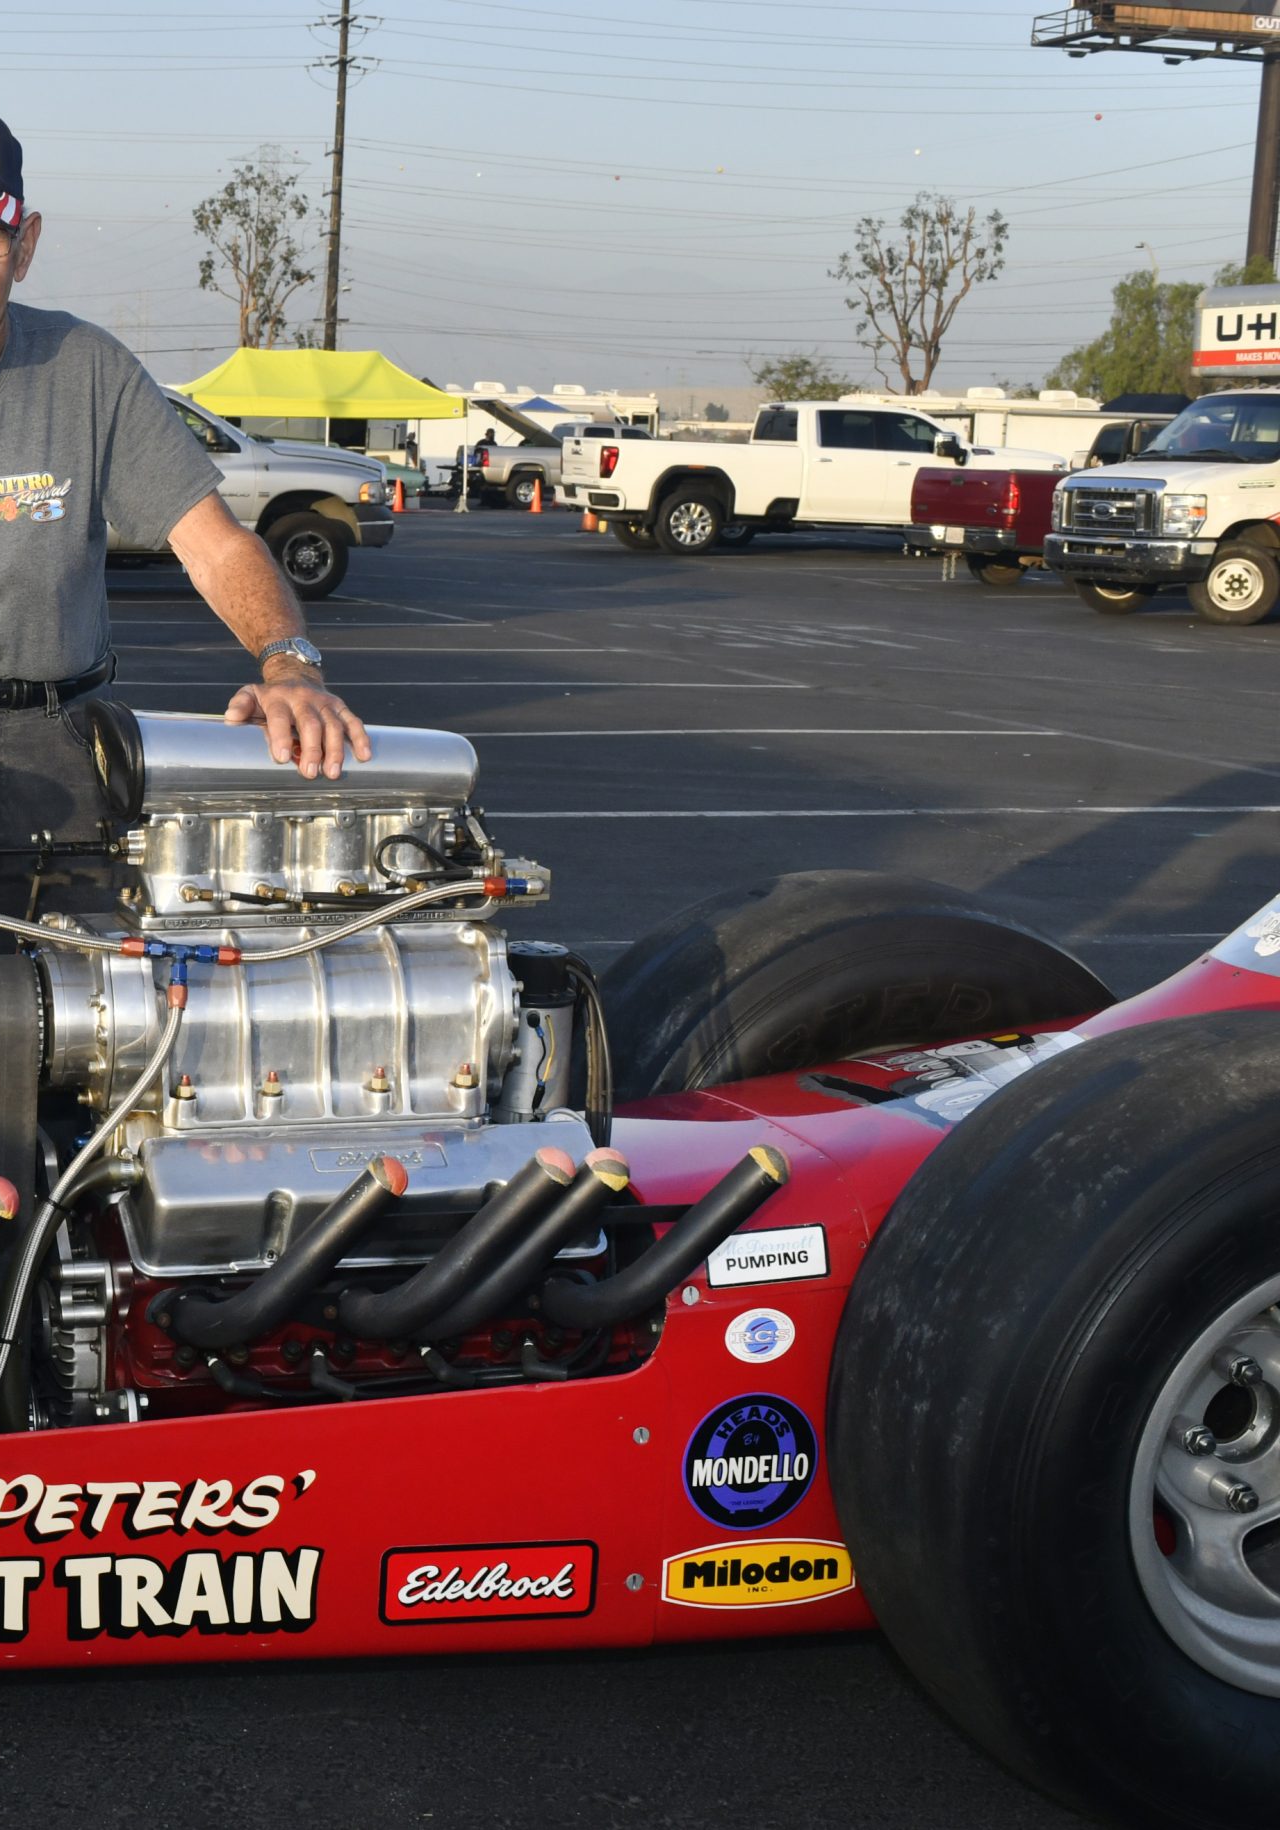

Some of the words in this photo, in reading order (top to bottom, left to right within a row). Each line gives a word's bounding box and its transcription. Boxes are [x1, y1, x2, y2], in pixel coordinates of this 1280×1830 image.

[1216, 311, 1280, 342] U-H
[13, 478, 72, 508] Revival
[717, 1234, 816, 1257] McDermott
[726, 1250, 809, 1271] PUMPING
[731, 1328, 791, 1345] RCS
[716, 1405, 791, 1440] HEADS
[690, 1453, 810, 1488] MONDELLO
[397, 1561, 576, 1607] Edelbrock
[683, 1555, 839, 1589] Milodon
[58, 1547, 323, 1636] TRAIN
